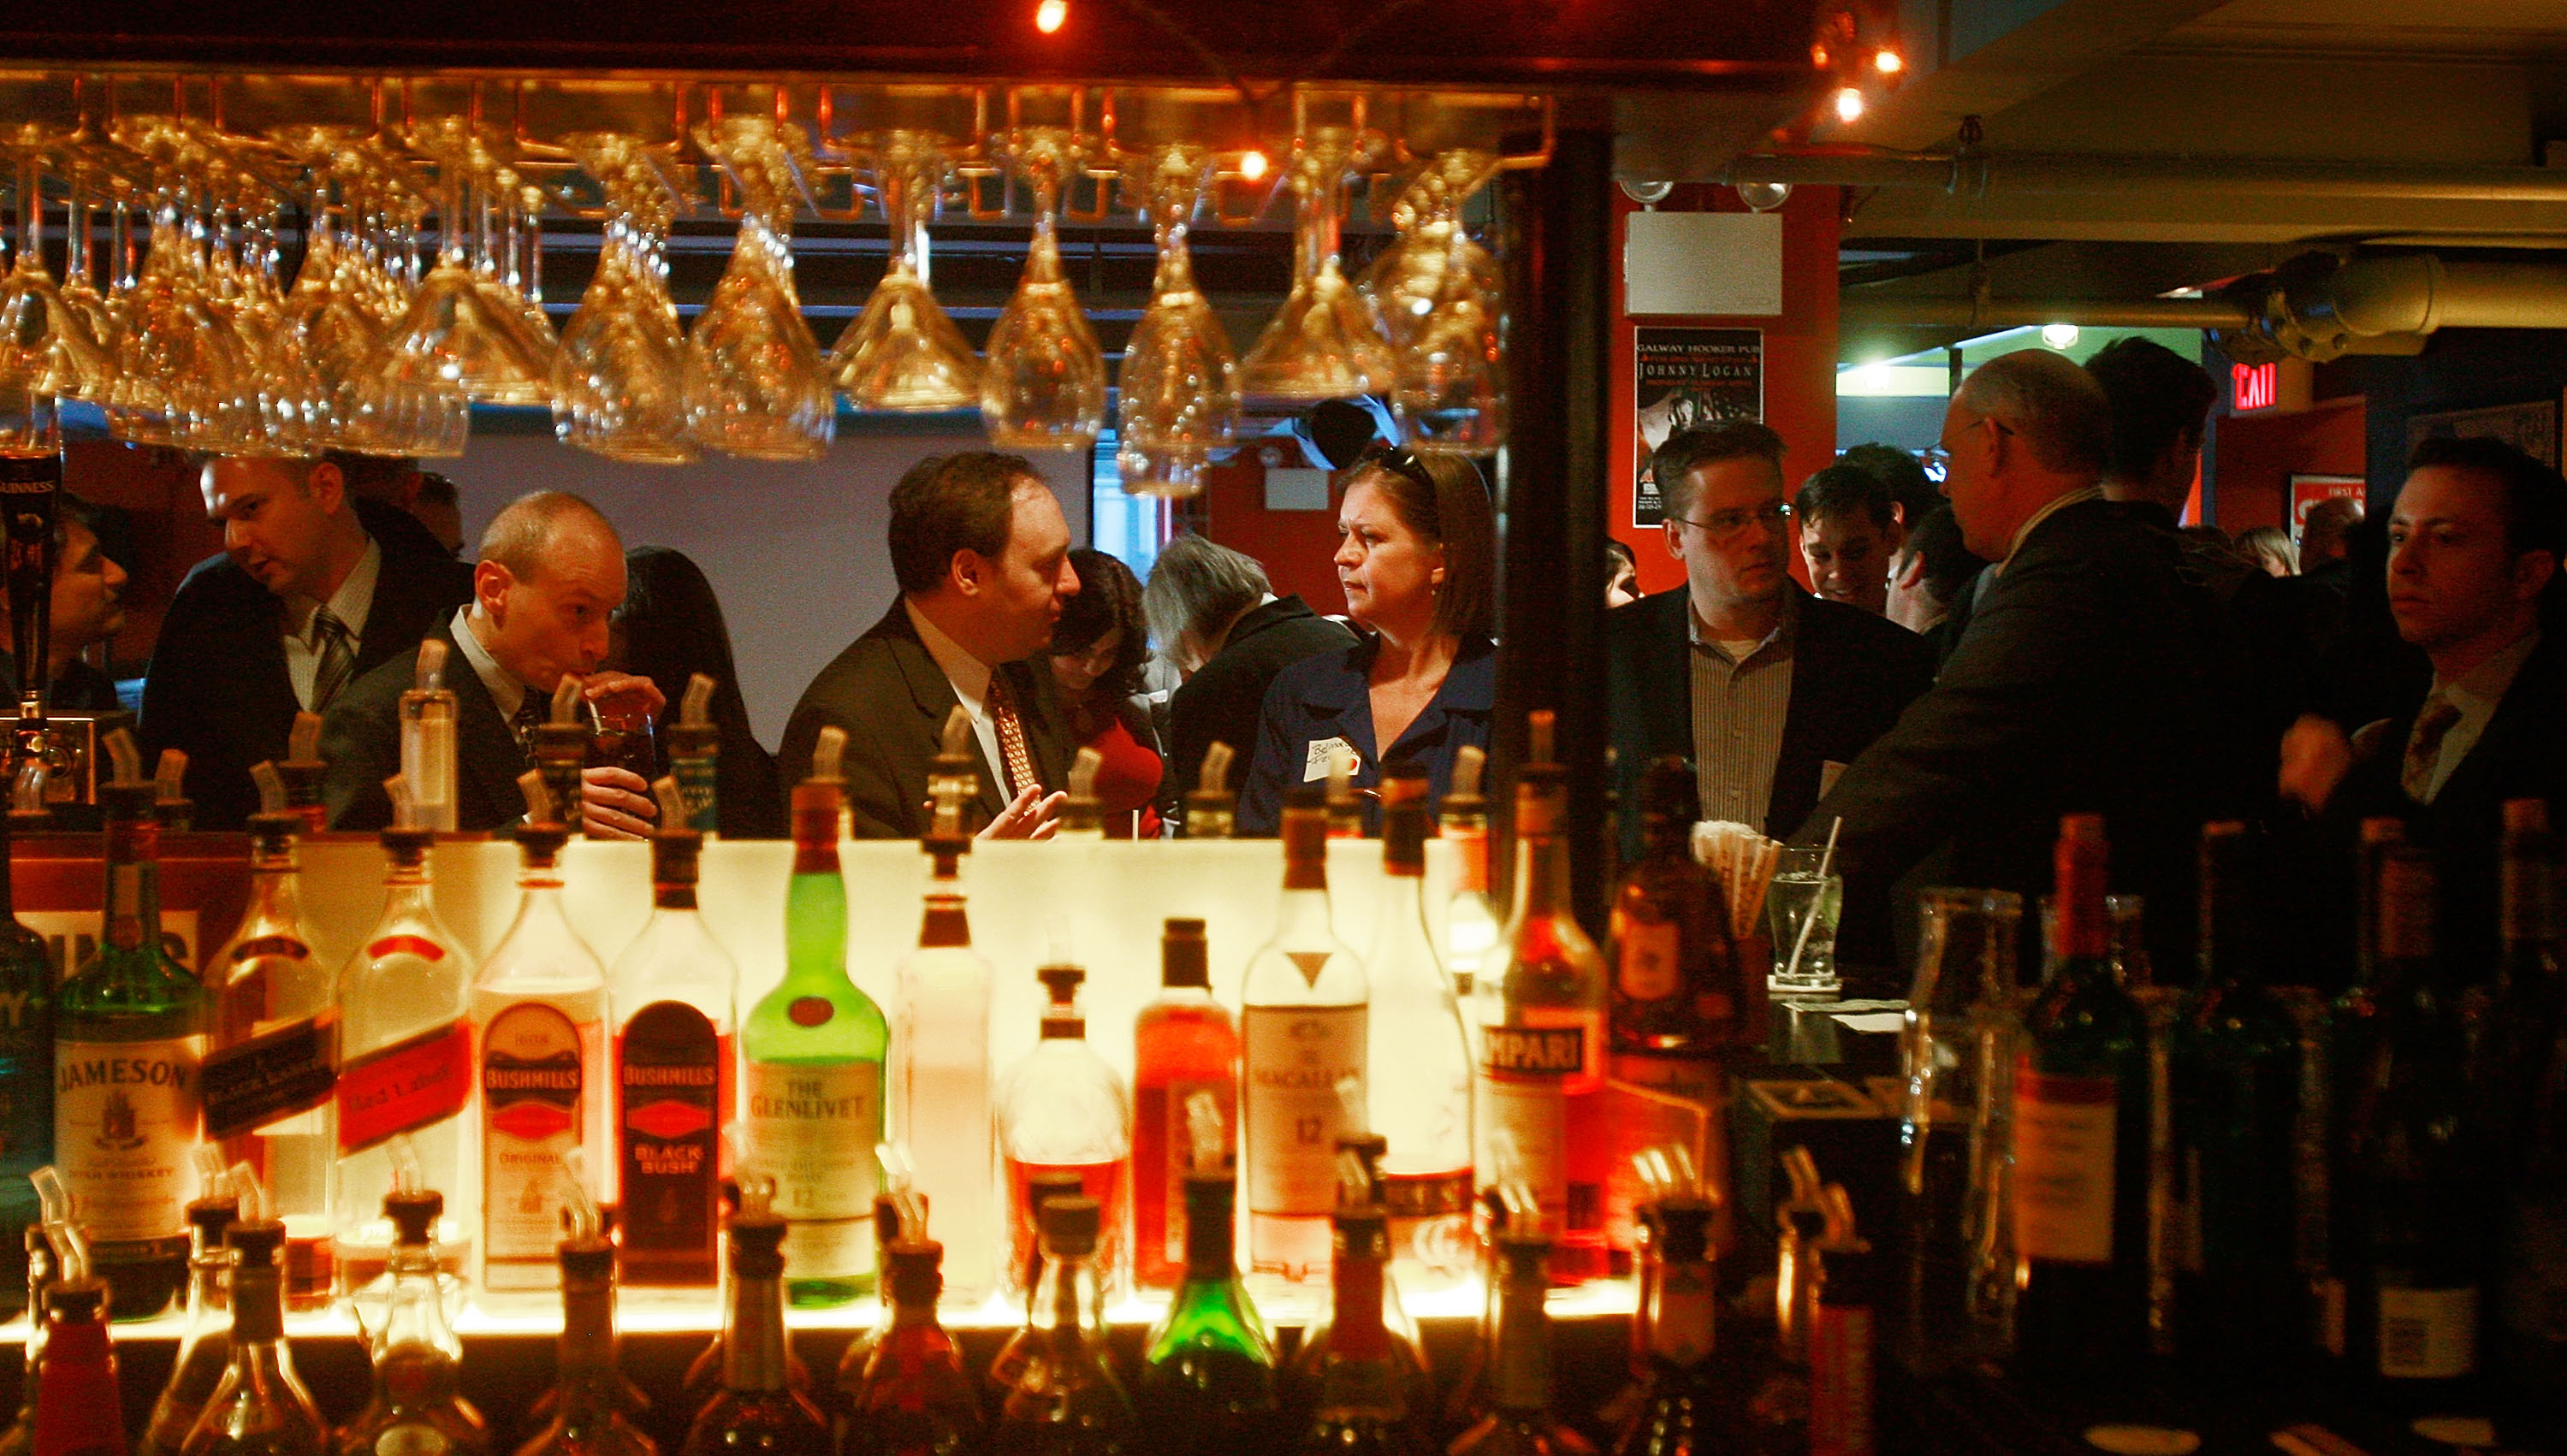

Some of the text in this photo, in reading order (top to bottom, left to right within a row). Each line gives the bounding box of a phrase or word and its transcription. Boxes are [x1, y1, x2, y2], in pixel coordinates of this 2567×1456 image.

[1637, 344, 1683, 353] GALWAY
[1687, 345, 1736, 353] HOOKER
[1639, 363, 1752, 380] JOHNNY LOGAN
[0, 480, 55, 494] UINNESS
[60, 1059, 187, 1092] JAMESON
[486, 1067, 578, 1089] BUSHMILLS
[623, 1065, 715, 1086] BUSHMILLS
[787, 1080, 822, 1097] THE
[750, 1094, 864, 1119] GLENLIVET
[635, 1144, 703, 1161] BLACK
[642, 1161, 698, 1175] BUSH
